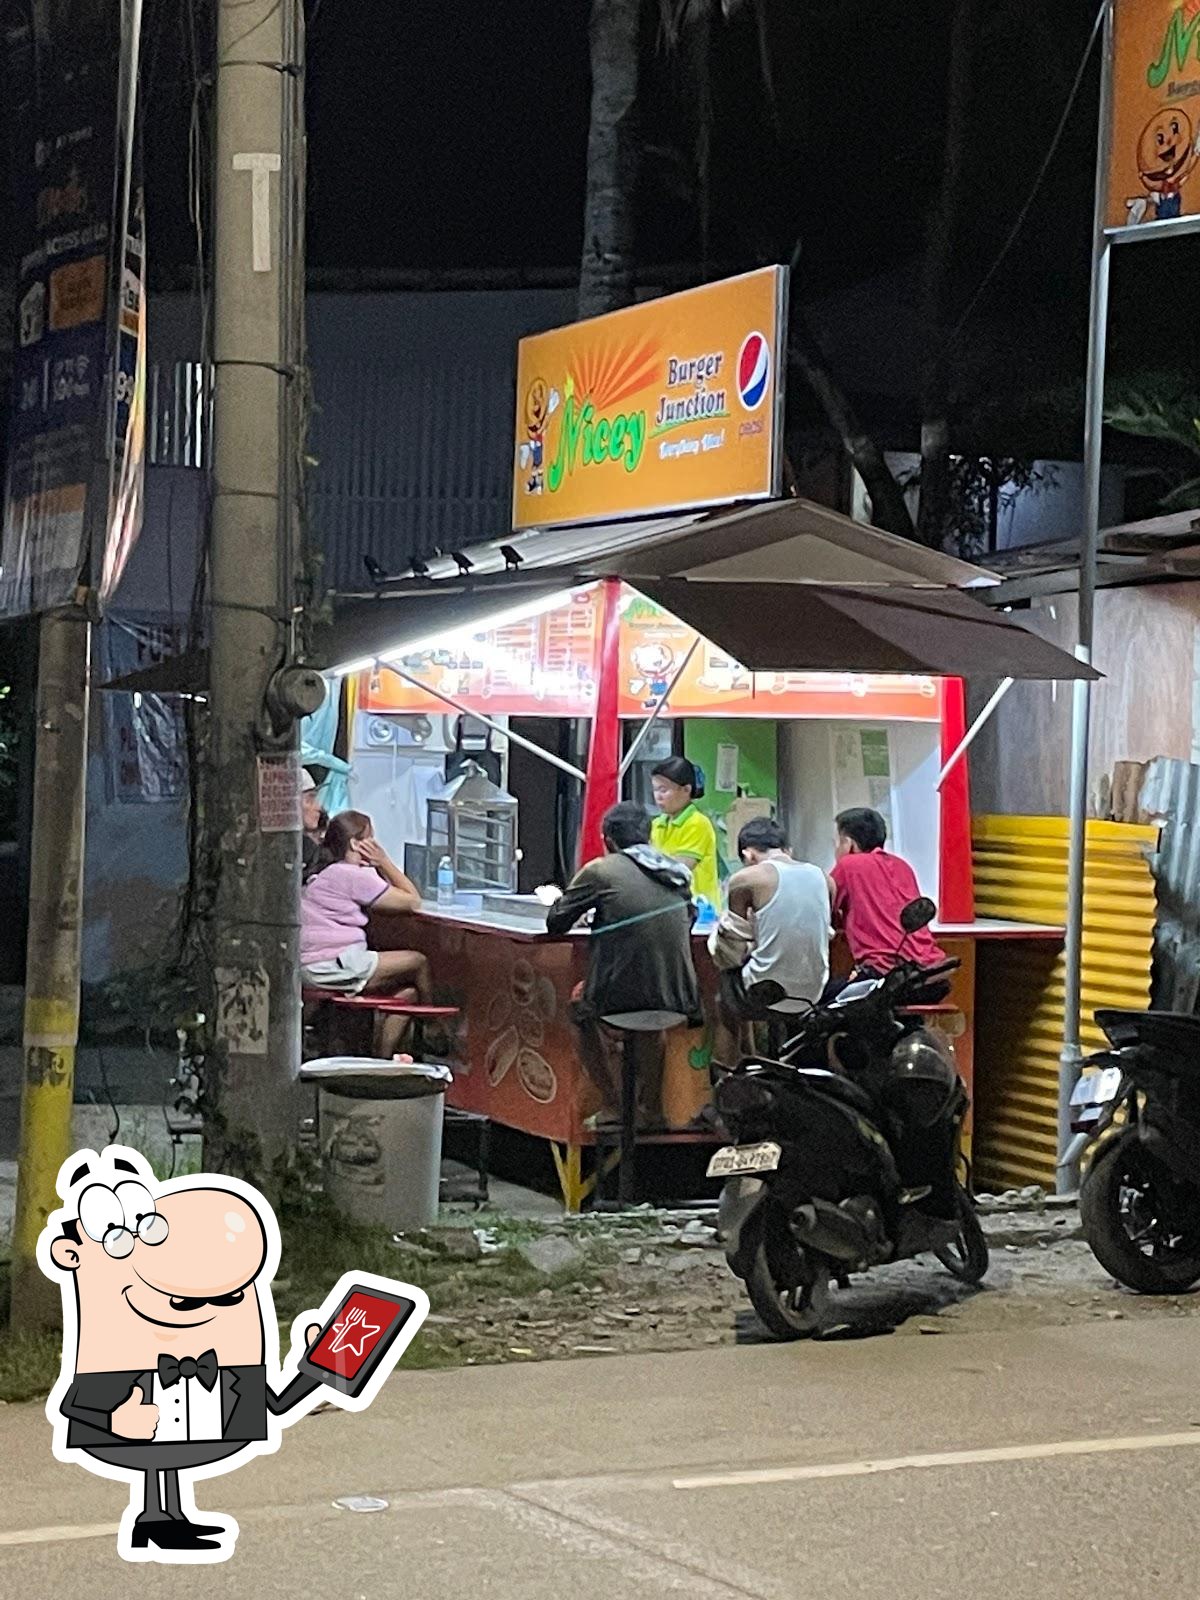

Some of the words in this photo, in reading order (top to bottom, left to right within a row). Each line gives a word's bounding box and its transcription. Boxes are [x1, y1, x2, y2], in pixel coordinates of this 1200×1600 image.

[232, 152, 281, 272] T
[667, 354, 723, 388] Burger
[655, 389, 726, 424] Junction
[548, 391, 646, 492] Nicey
